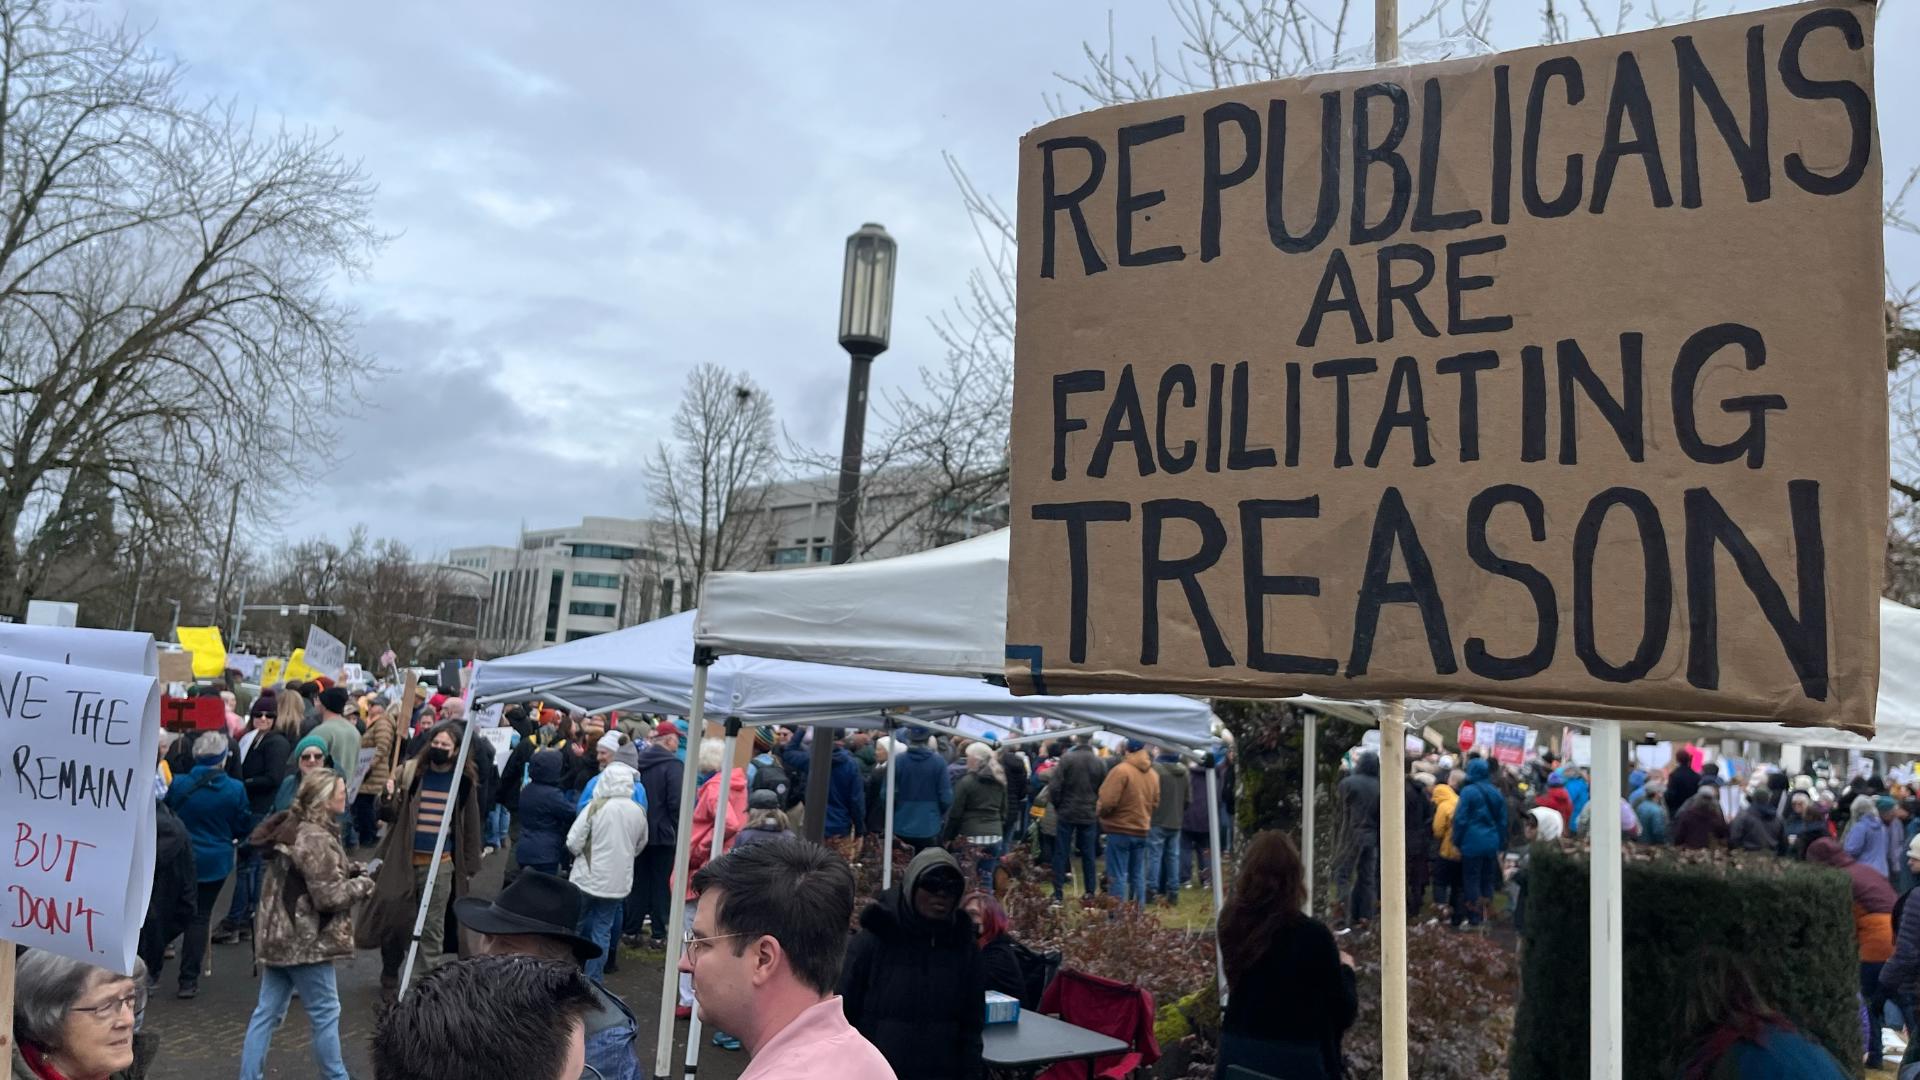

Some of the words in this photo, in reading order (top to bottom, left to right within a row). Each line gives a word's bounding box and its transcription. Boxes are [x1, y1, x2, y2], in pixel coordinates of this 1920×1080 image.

[1037, 8, 1872, 279] REPUBLICANS
[1296, 234, 1514, 348] ARE
[1052, 322, 1788, 482] FACILITATING
[1031, 479, 1830, 702] TREASON
[66, 690, 131, 745] THE
[13, 744, 134, 812] REMAIN
[14, 822, 97, 882] BUT
